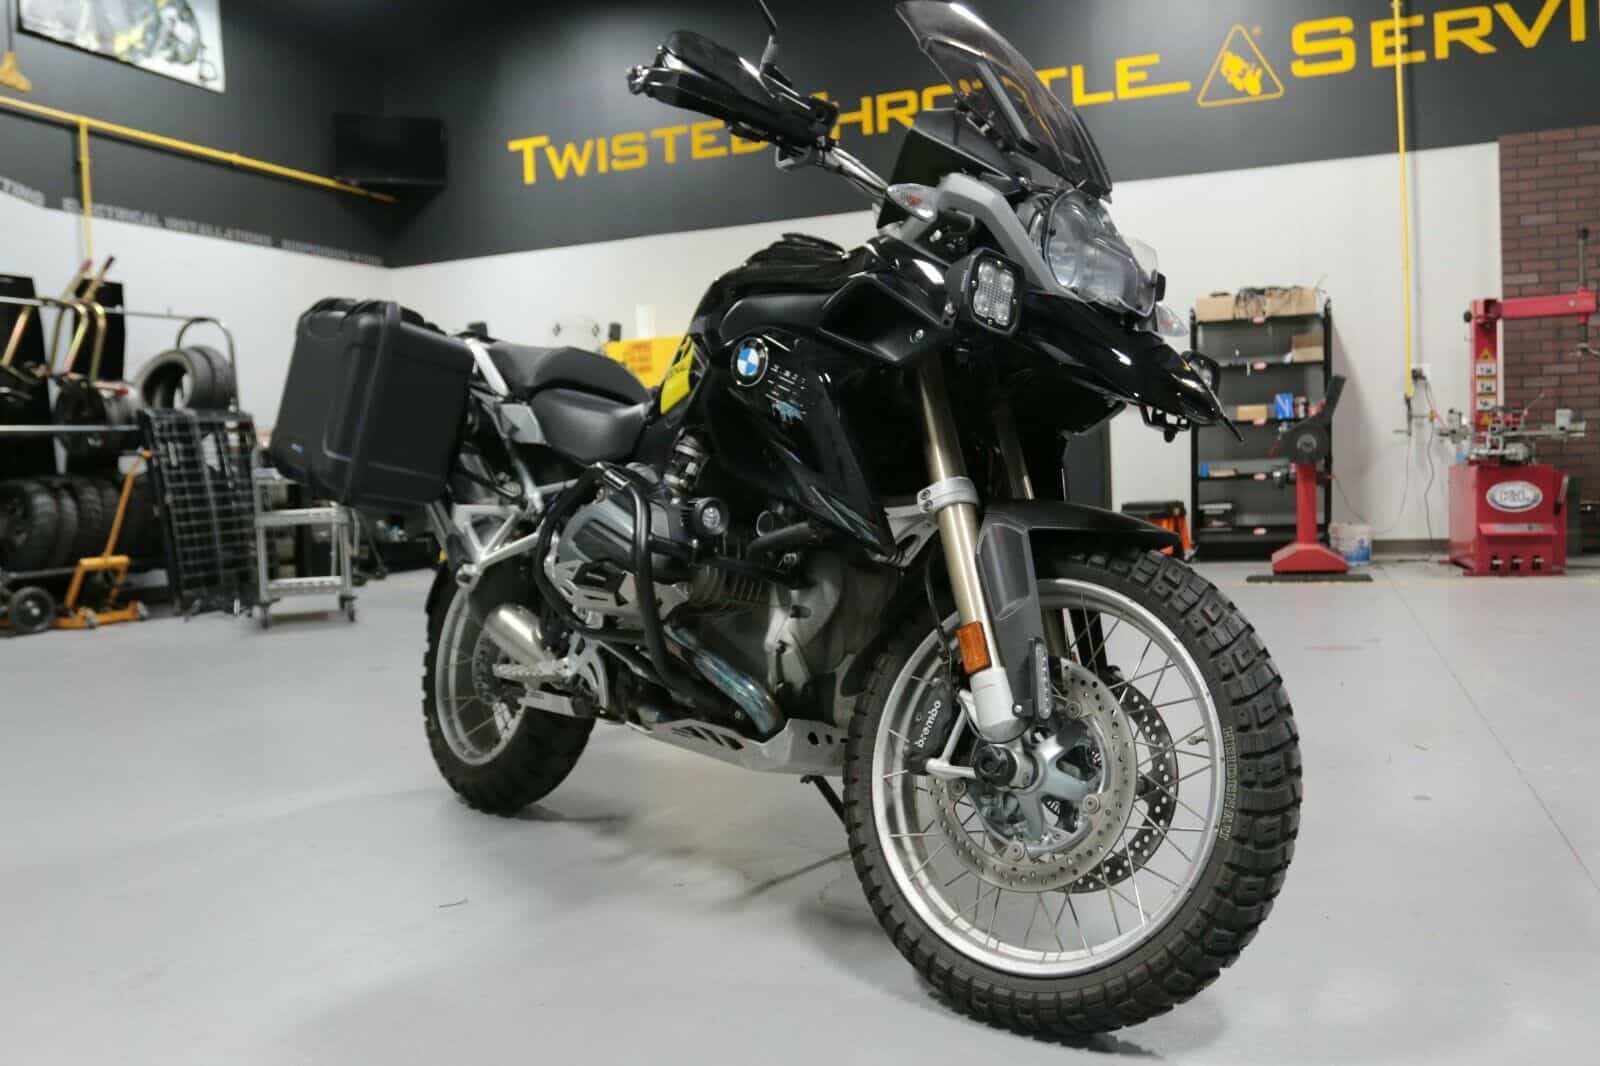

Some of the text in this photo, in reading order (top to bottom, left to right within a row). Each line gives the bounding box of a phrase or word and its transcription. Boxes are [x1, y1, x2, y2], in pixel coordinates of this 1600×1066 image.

[1290, 0, 1600, 78] SERVI
[61, 196, 162, 228] ECTRICAL
[914, 700, 941, 748] brembo
